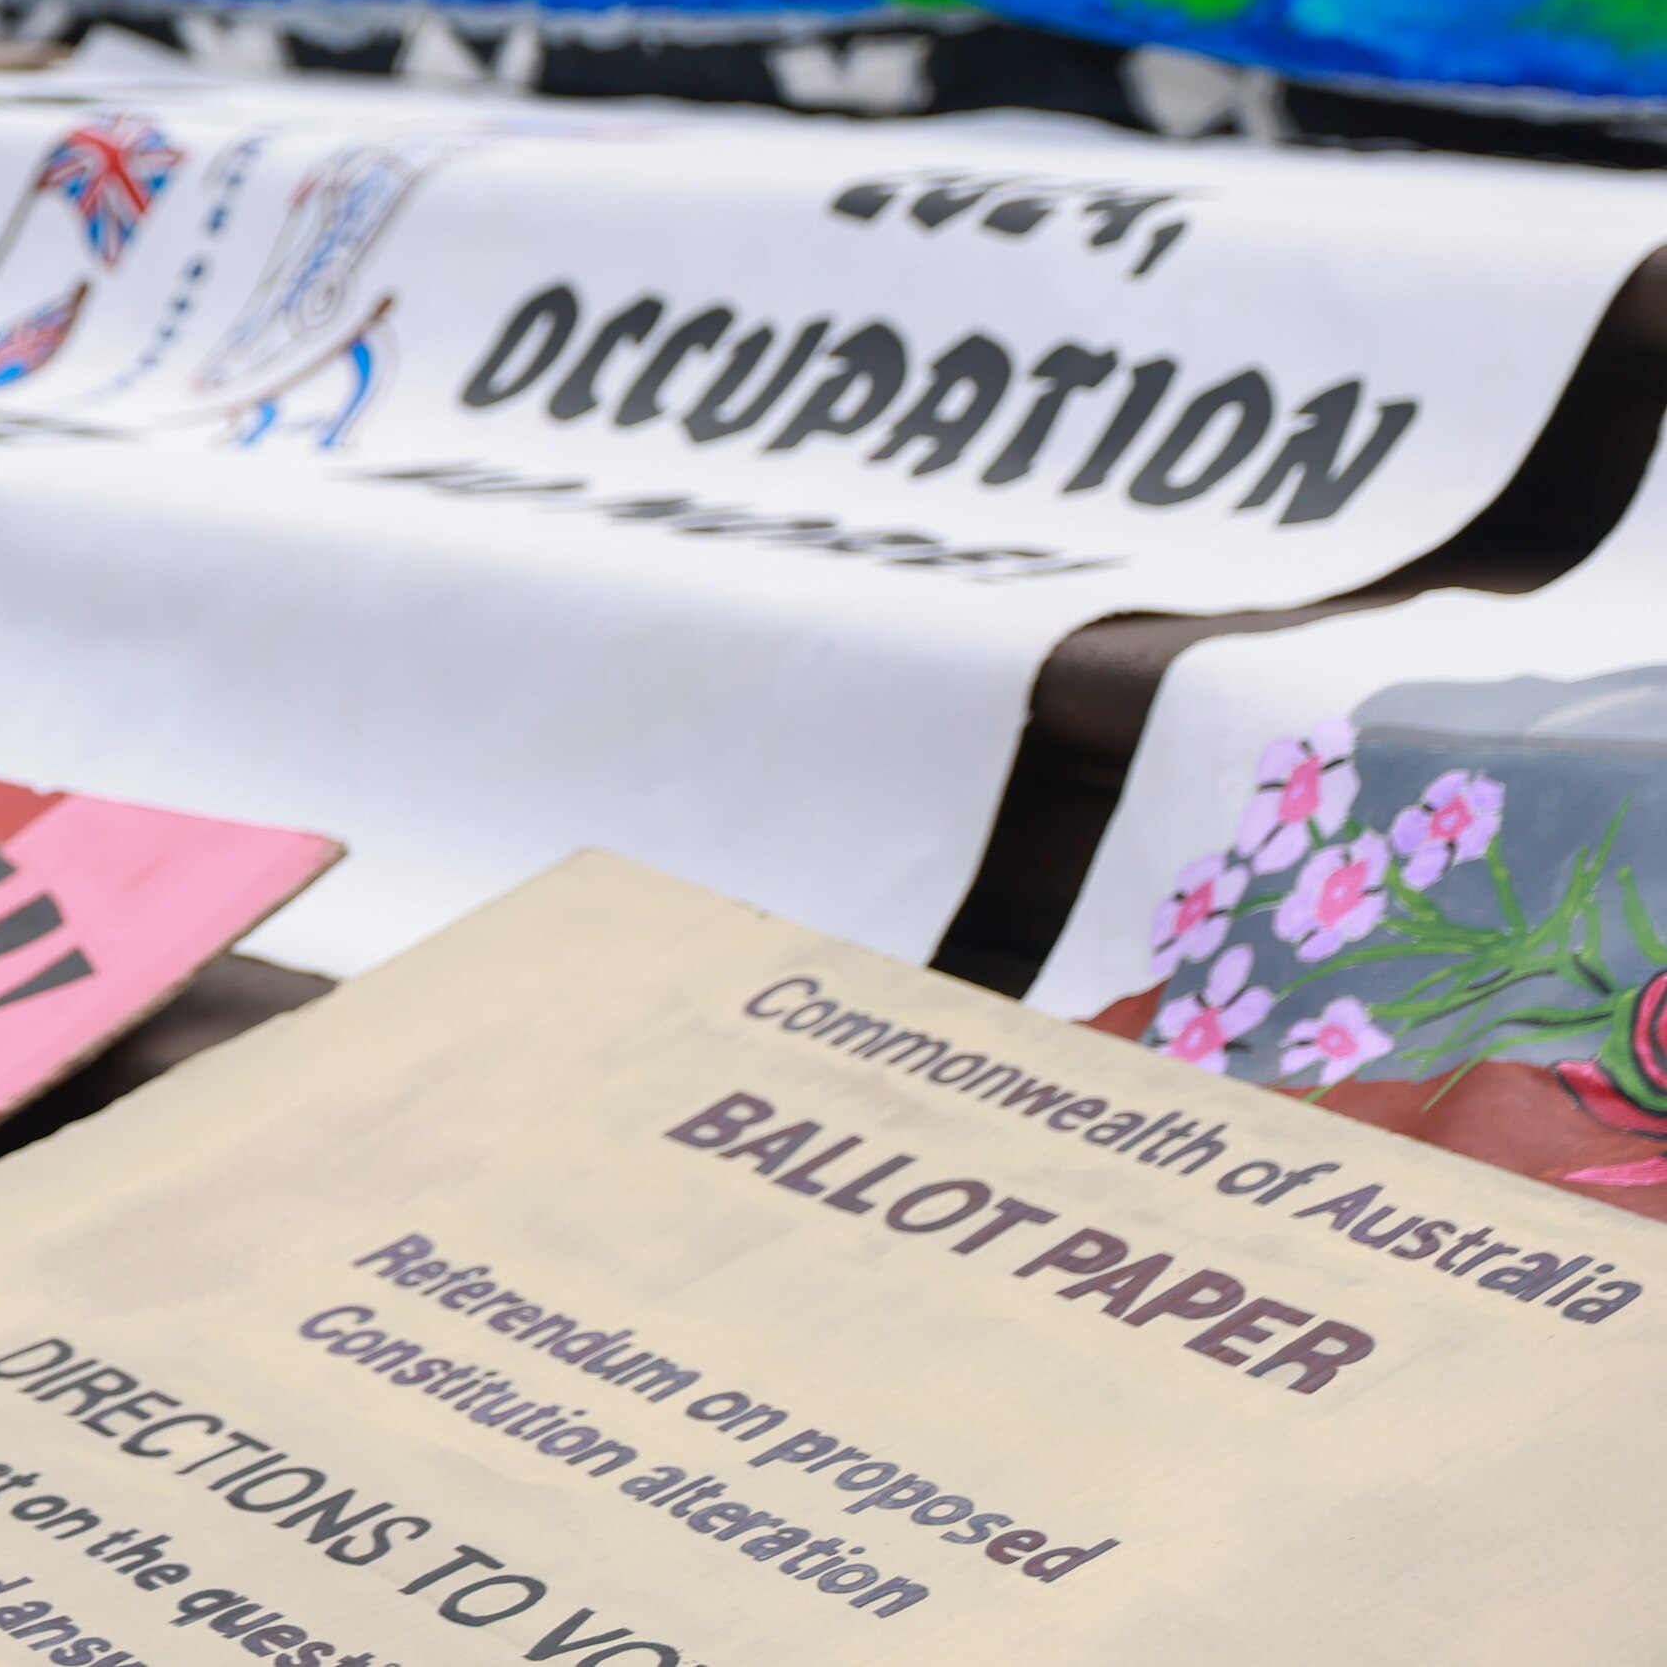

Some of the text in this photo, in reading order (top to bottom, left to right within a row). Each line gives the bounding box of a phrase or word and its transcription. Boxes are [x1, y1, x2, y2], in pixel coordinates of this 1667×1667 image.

[459, 278, 1421, 526] OCCUPATION
[663, 1089, 1378, 1397] BALLOT PAPER
[742, 972, 1645, 1327] Commonwealth of Australia
[9, 1493, 103, 1541] on
[85, 1527, 191, 1593] the
[298, 1303, 931, 1620] Constitution alteration
[352, 1230, 1122, 1586] Referendum on proposed
[397, 1543, 548, 1627] TO
